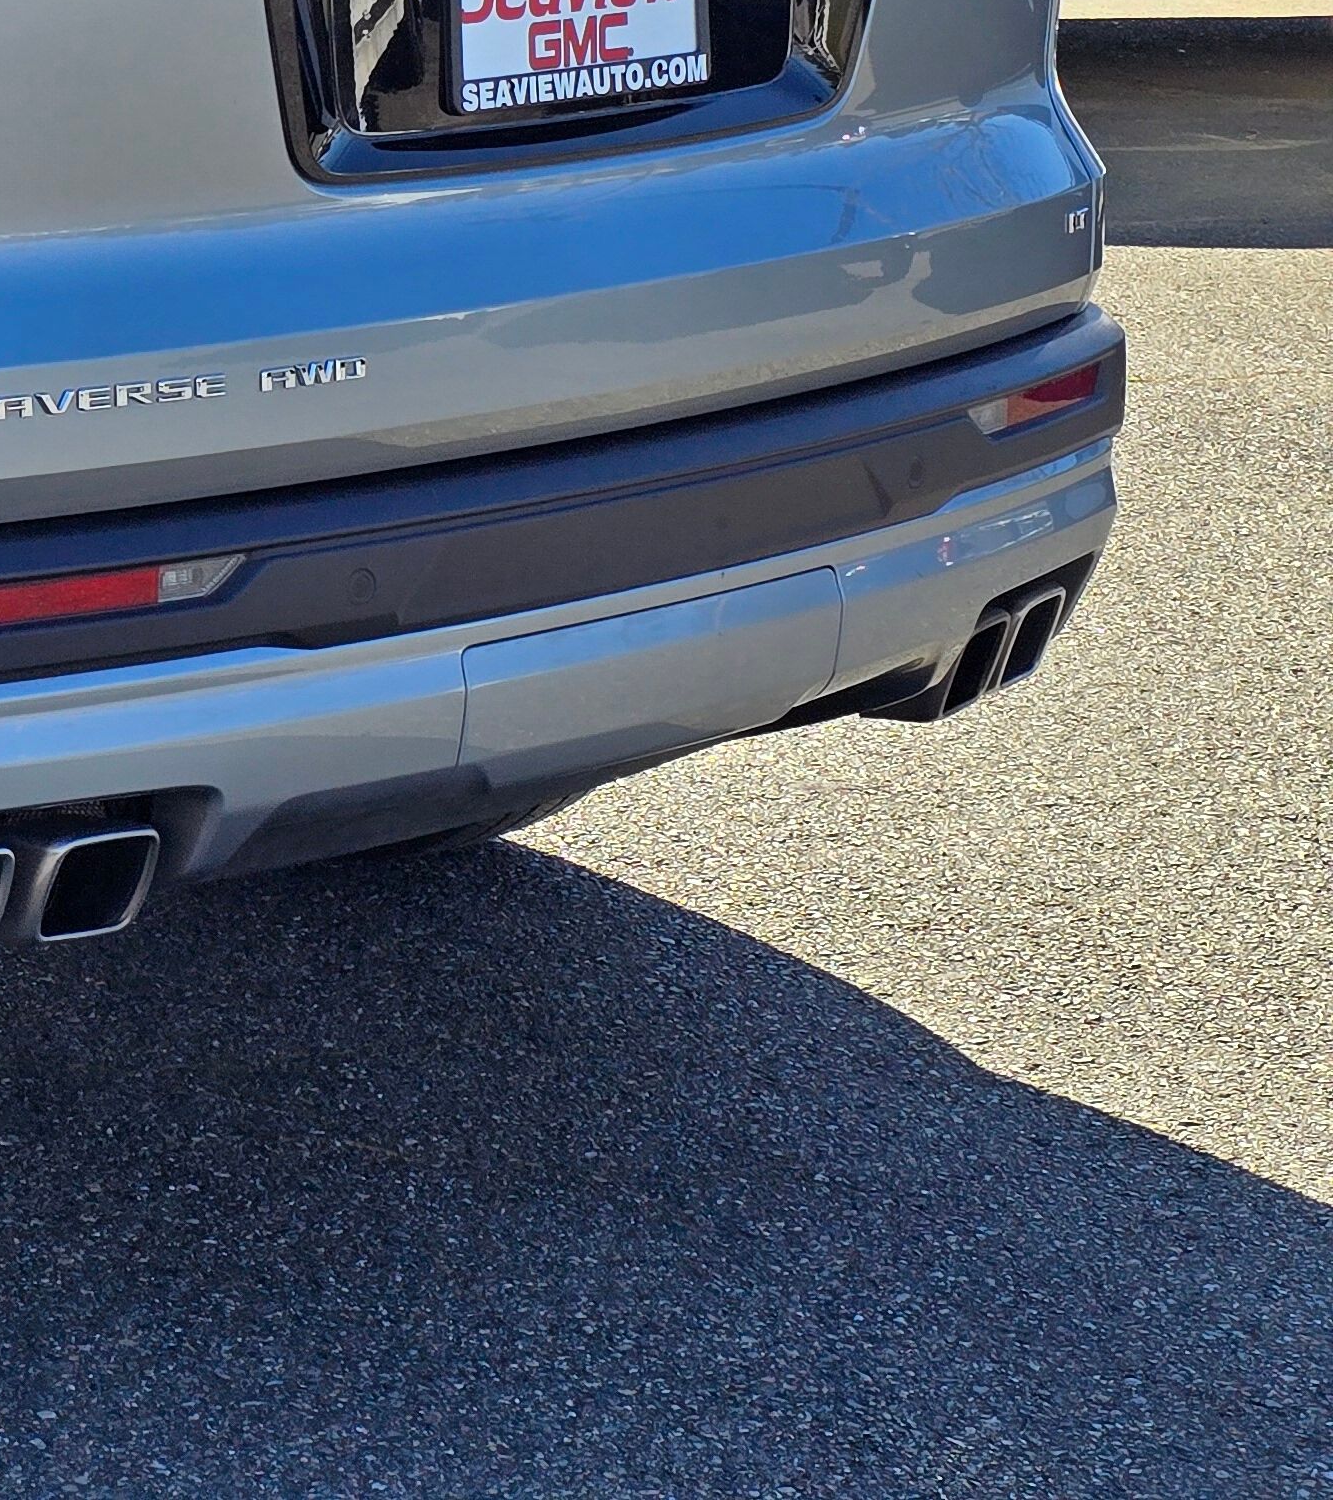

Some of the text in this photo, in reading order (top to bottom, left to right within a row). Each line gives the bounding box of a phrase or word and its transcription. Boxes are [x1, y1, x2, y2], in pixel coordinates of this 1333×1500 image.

[528, 12, 631, 71] GMC
[462, 53, 708, 112] SEAVIEWAUTO.COM
[259, 356, 367, 392] AWD
